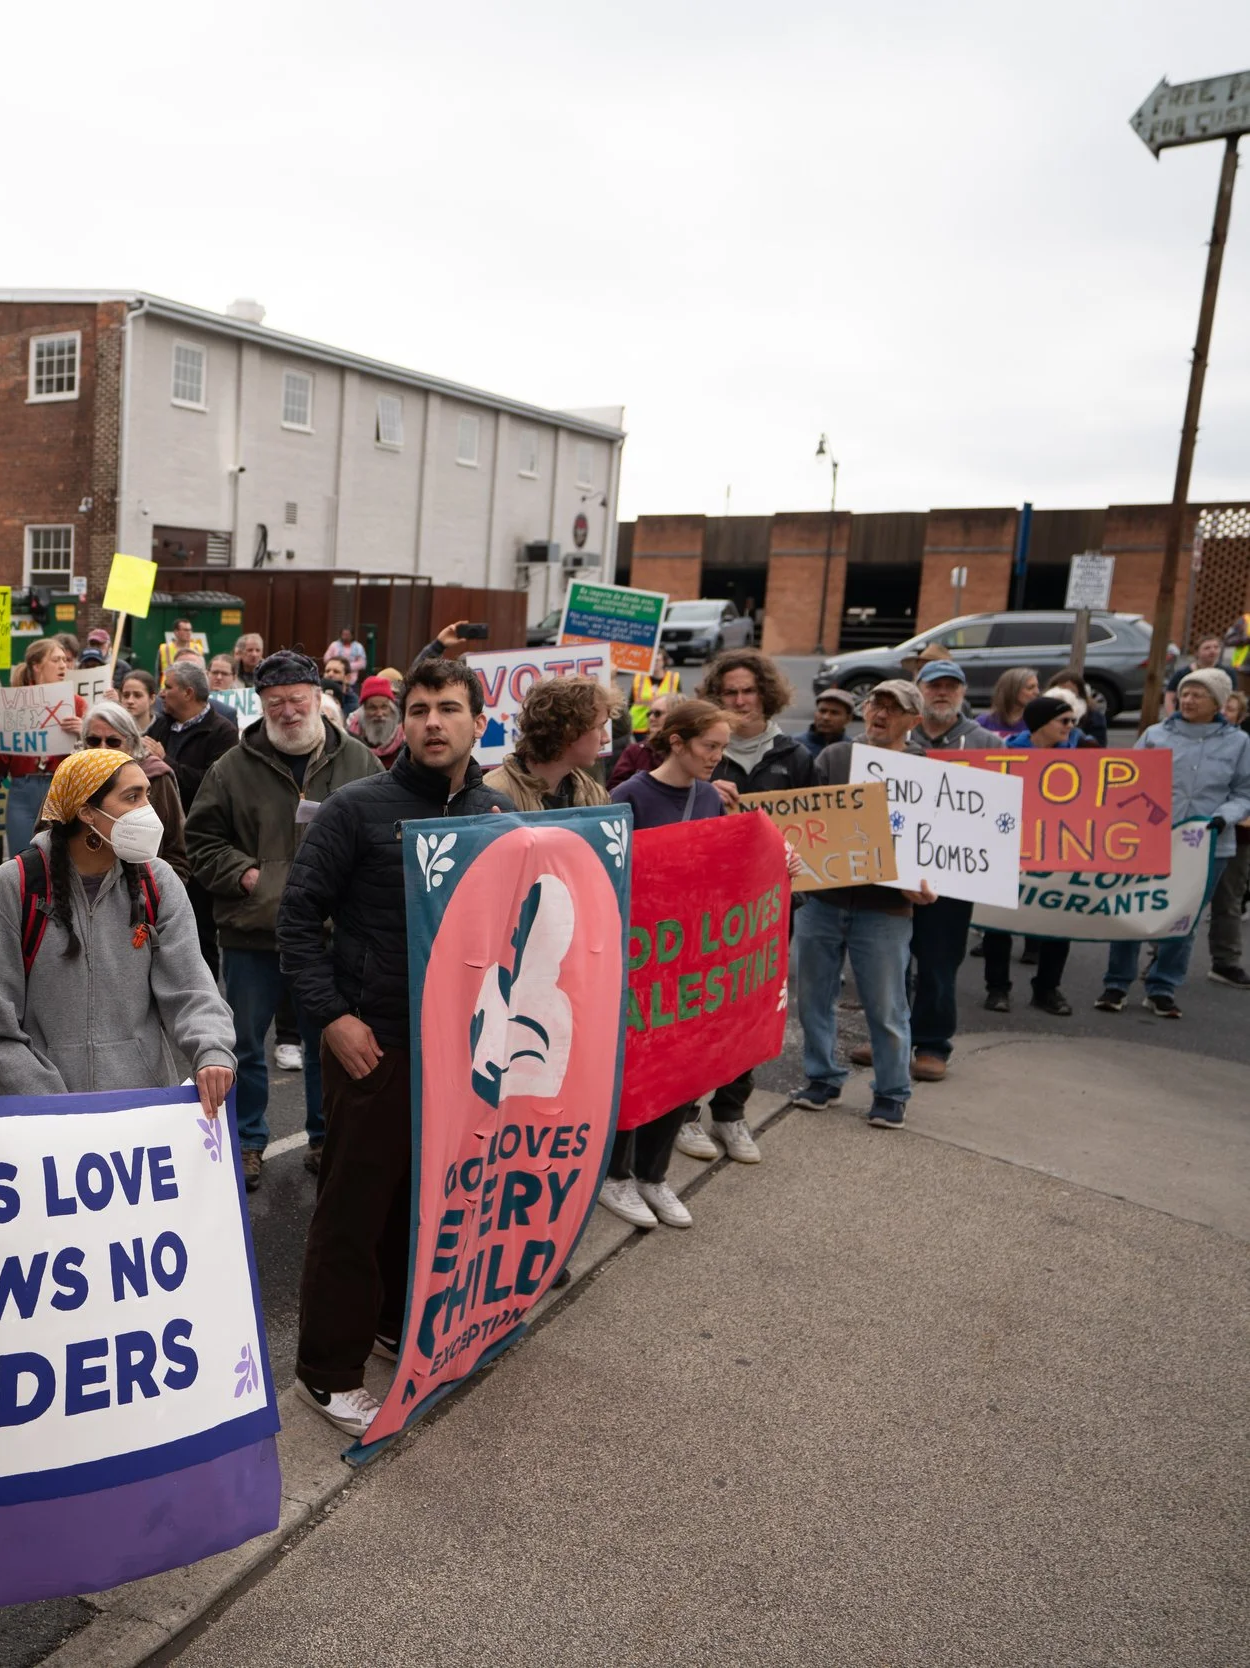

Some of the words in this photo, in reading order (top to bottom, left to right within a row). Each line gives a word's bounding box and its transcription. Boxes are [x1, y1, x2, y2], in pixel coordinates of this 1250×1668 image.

[1, 687, 51, 709] WILL
[473, 657, 603, 707] VOTE
[3, 709, 26, 731] BE
[867, 762, 922, 804] SEND
[936, 772, 985, 817] AID,
[778, 819, 828, 848] OR
[917, 823, 989, 873] BOMBS
[1020, 819, 1141, 862] LING
[1018, 884, 1169, 916] IGRANTS
[628, 919, 684, 970] OD
[701, 884, 781, 955] LOVES
[627, 936, 780, 1032] ALESTINE
[487, 1122, 591, 1166] LOVES
[42, 1145, 179, 1217] LOVE
[109, 1230, 188, 1302] NO
[417, 1239, 556, 1359] CHILD
